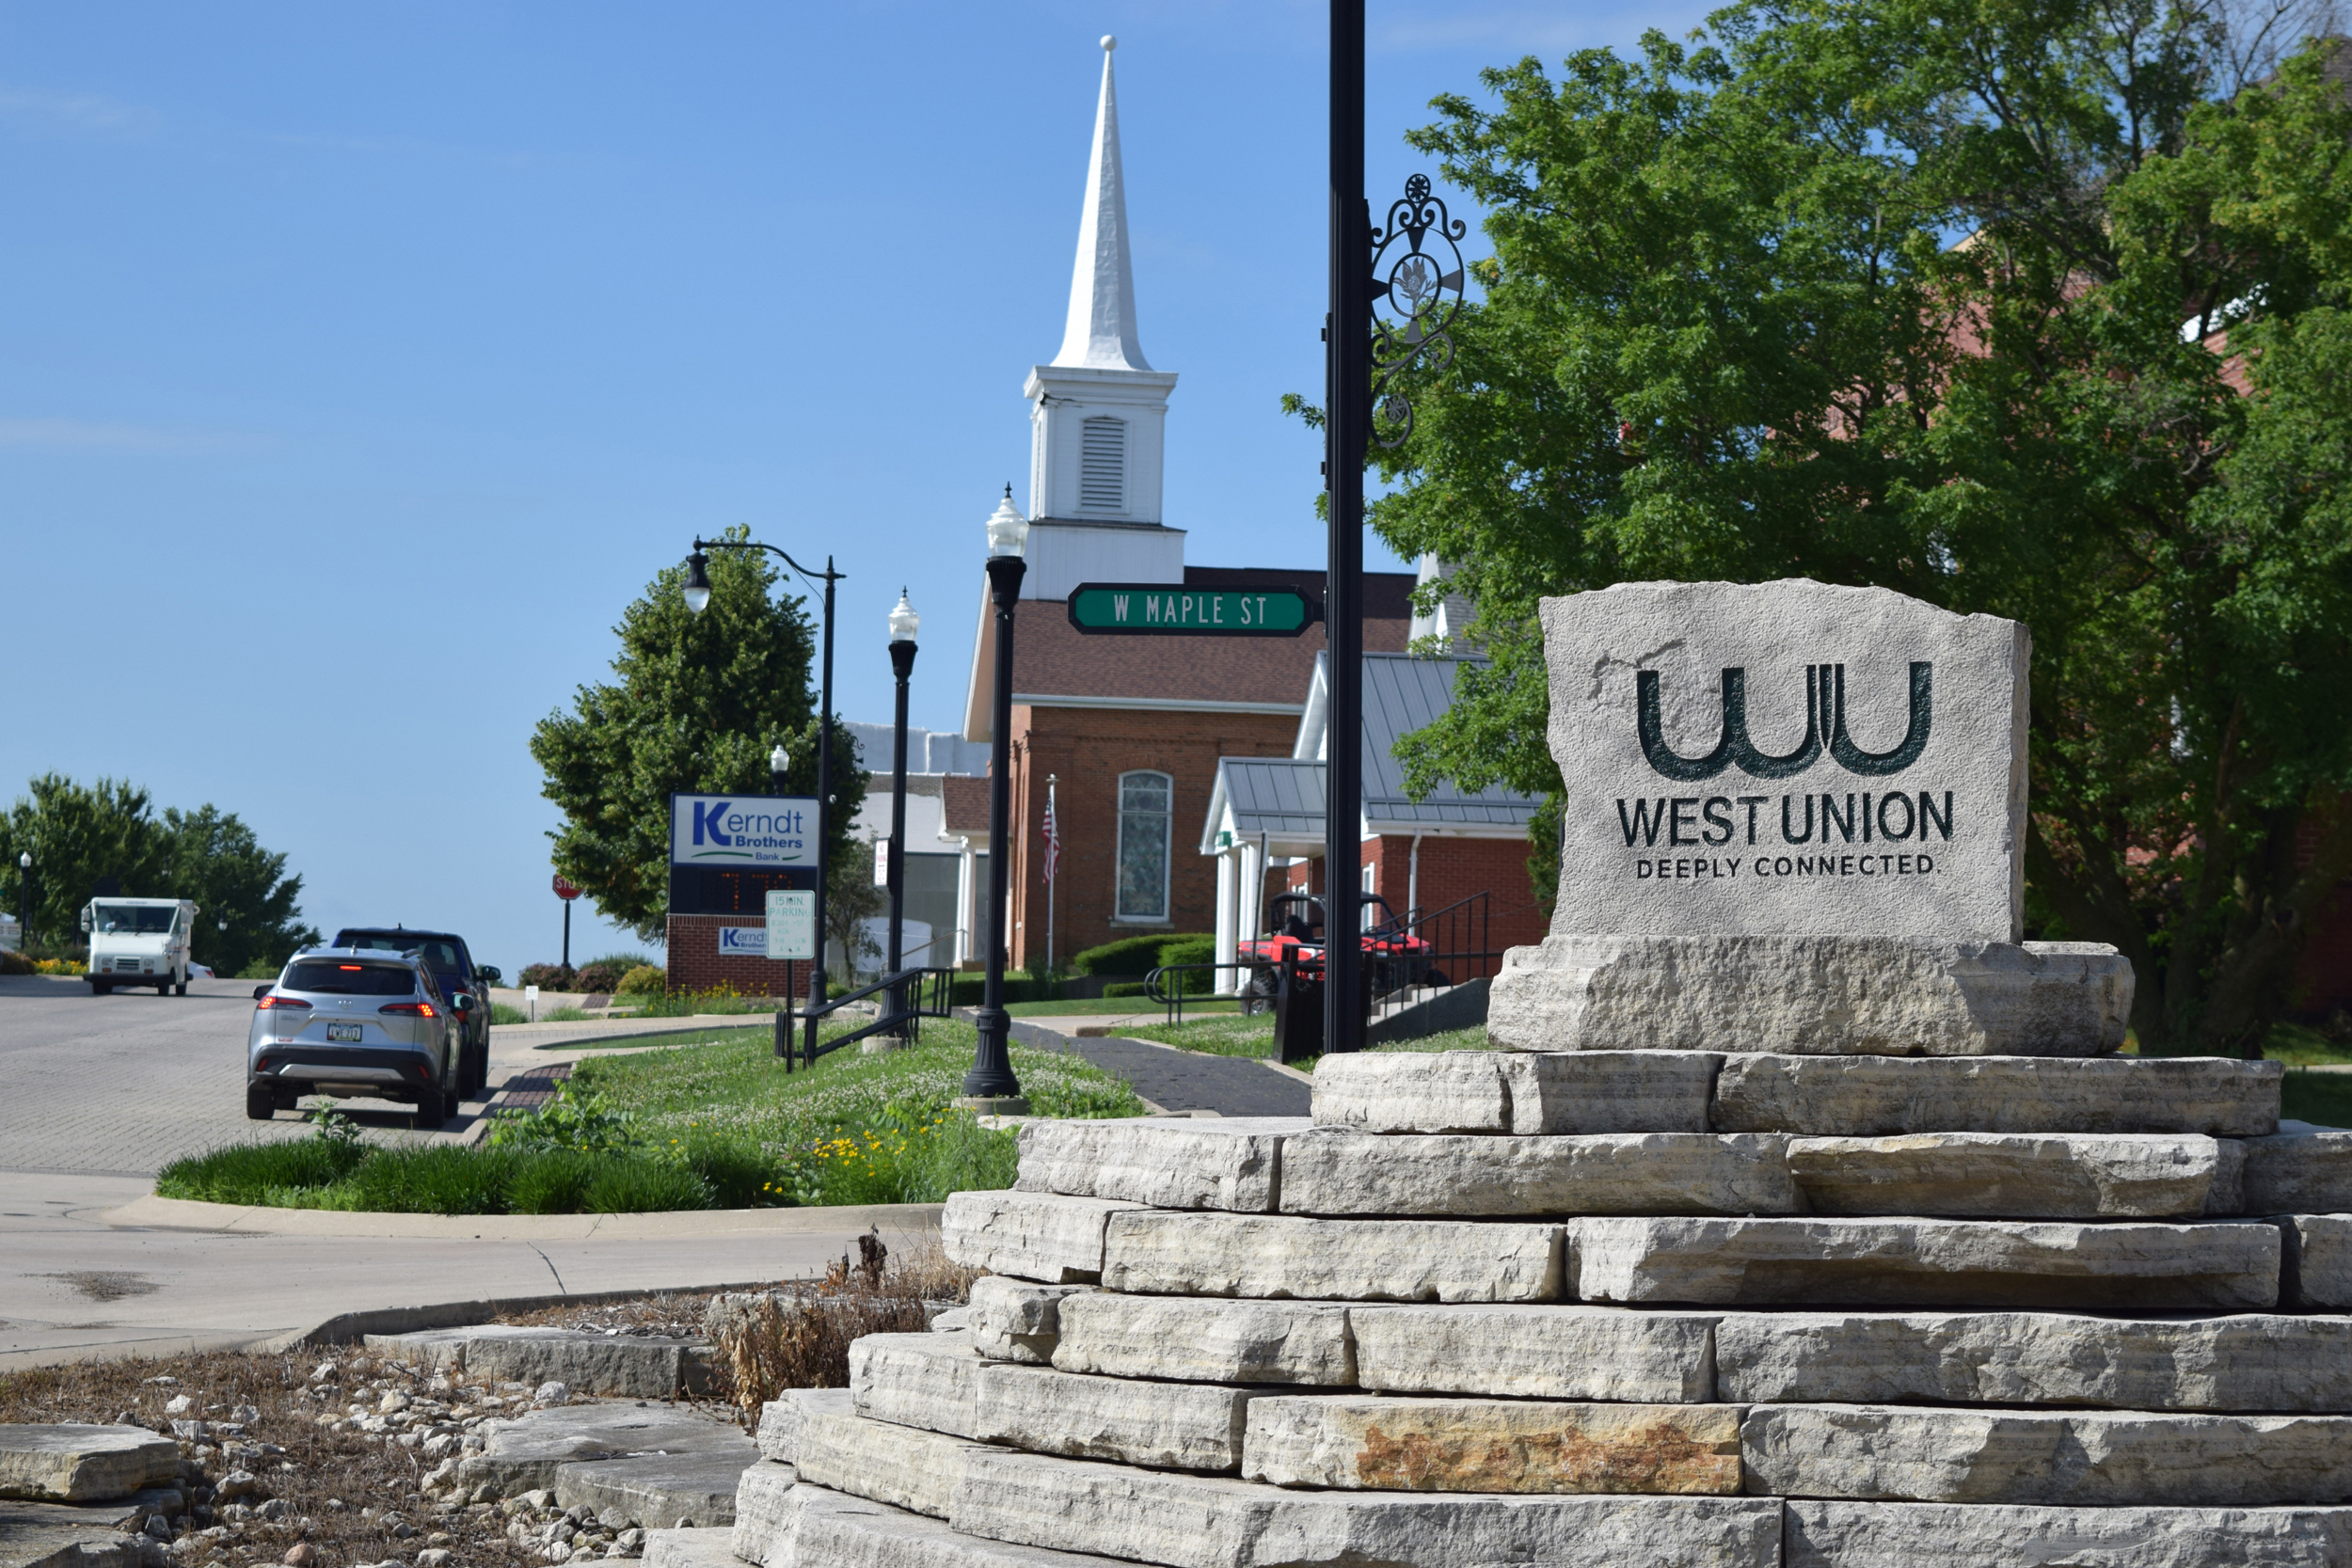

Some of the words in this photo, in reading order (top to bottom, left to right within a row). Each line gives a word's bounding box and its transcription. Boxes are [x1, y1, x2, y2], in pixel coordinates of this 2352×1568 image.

[1114, 594, 1129, 622] W
[1146, 594, 1223, 624] MAPLE
[1240, 596, 1266, 625] ST
[692, 800, 803, 847] Kerndt
[1616, 796, 1769, 847] WEST
[1781, 790, 1954, 845] UNION
[735, 834, 803, 848] Brothers
[755, 851, 780, 861] Bank
[1637, 857, 1741, 879] DEEPLY
[775, 896, 785, 906] 15
[787, 896, 805, 906] MIN.
[770, 907, 812, 917] PARKING
[723, 928, 766, 947] Kernd
